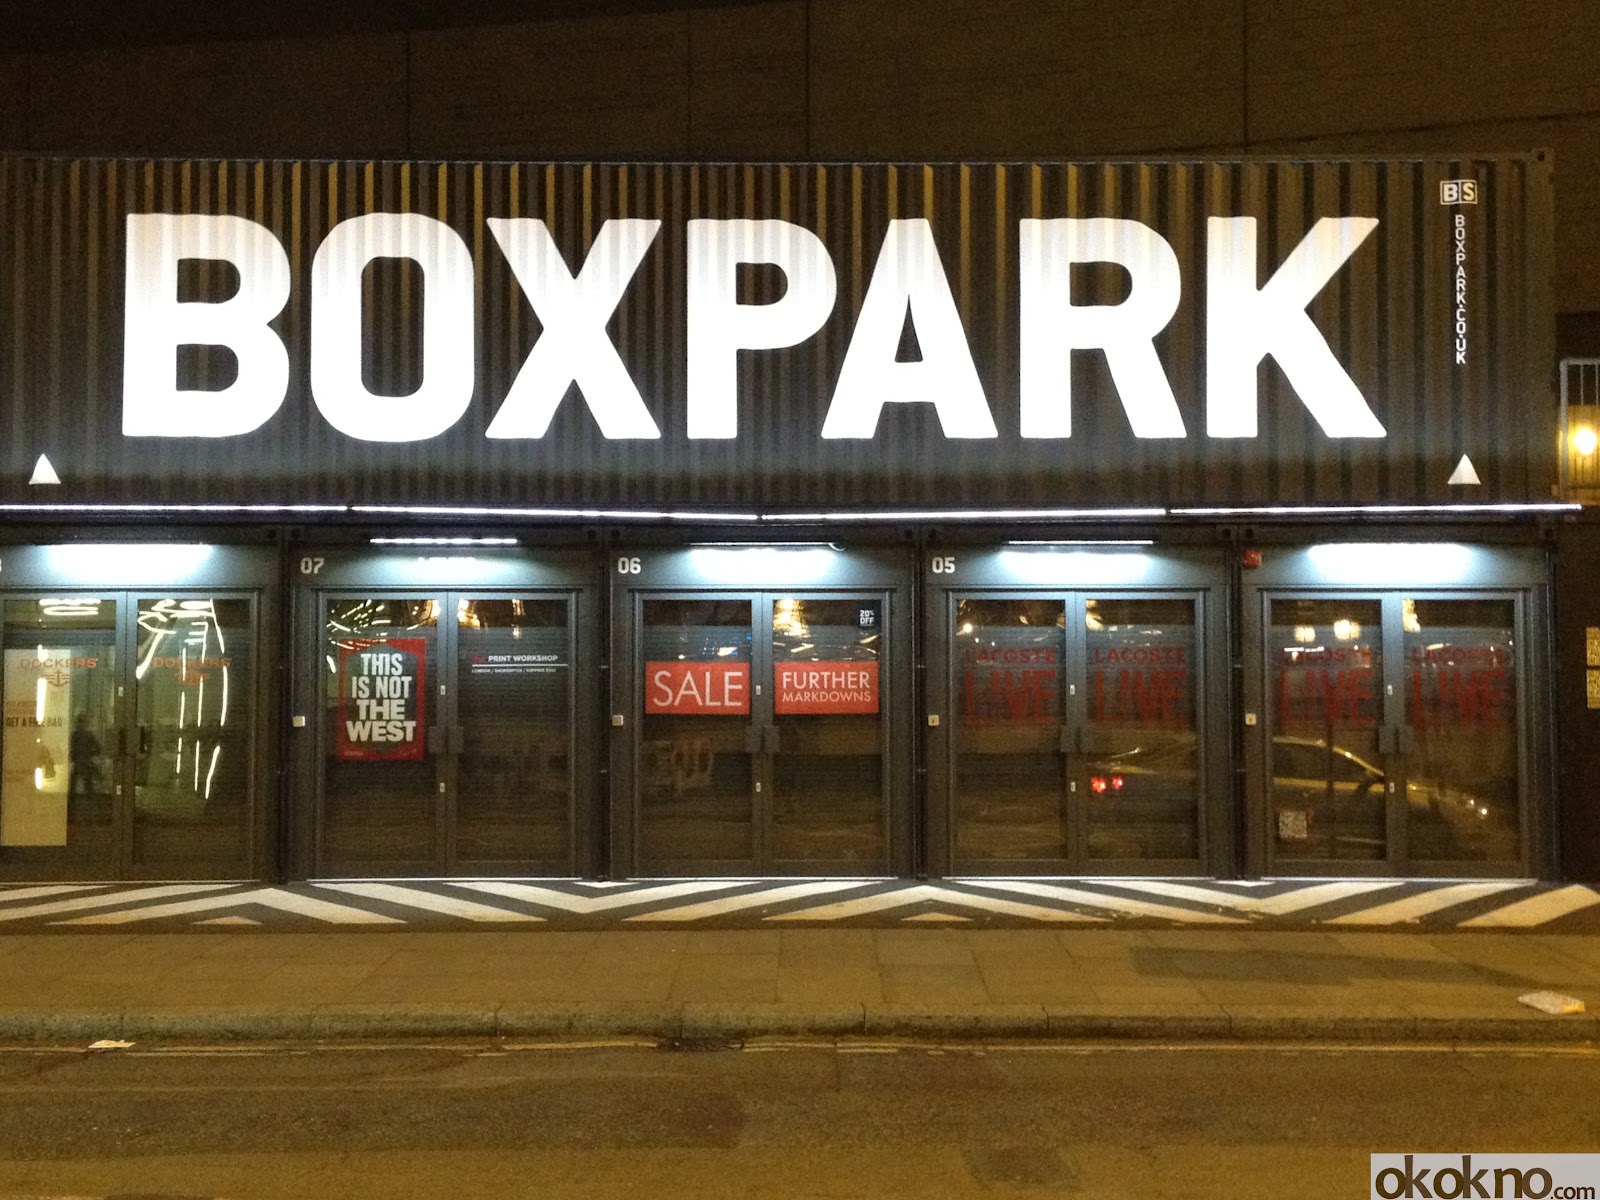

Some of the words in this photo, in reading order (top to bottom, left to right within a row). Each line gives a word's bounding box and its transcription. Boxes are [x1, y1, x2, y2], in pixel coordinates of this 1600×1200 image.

[1454, 214, 1467, 365] BOXPARK.CO.UK
[122, 212, 1387, 443] BOXPARK
[300, 557, 325, 575] 07
[617, 557, 642, 575] 06
[932, 556, 956, 574] 05
[859, 617, 875, 625] OFF
[360, 653, 403, 676] THIS
[351, 676, 370, 699] IS
[375, 676, 413, 699] NOT
[653, 669, 743, 707] SALE
[782, 671, 870, 689] FURTHER
[782, 691, 871, 703] MARKDOWNS
[356, 699, 406, 720] THE
[345, 720, 417, 742] WEST
